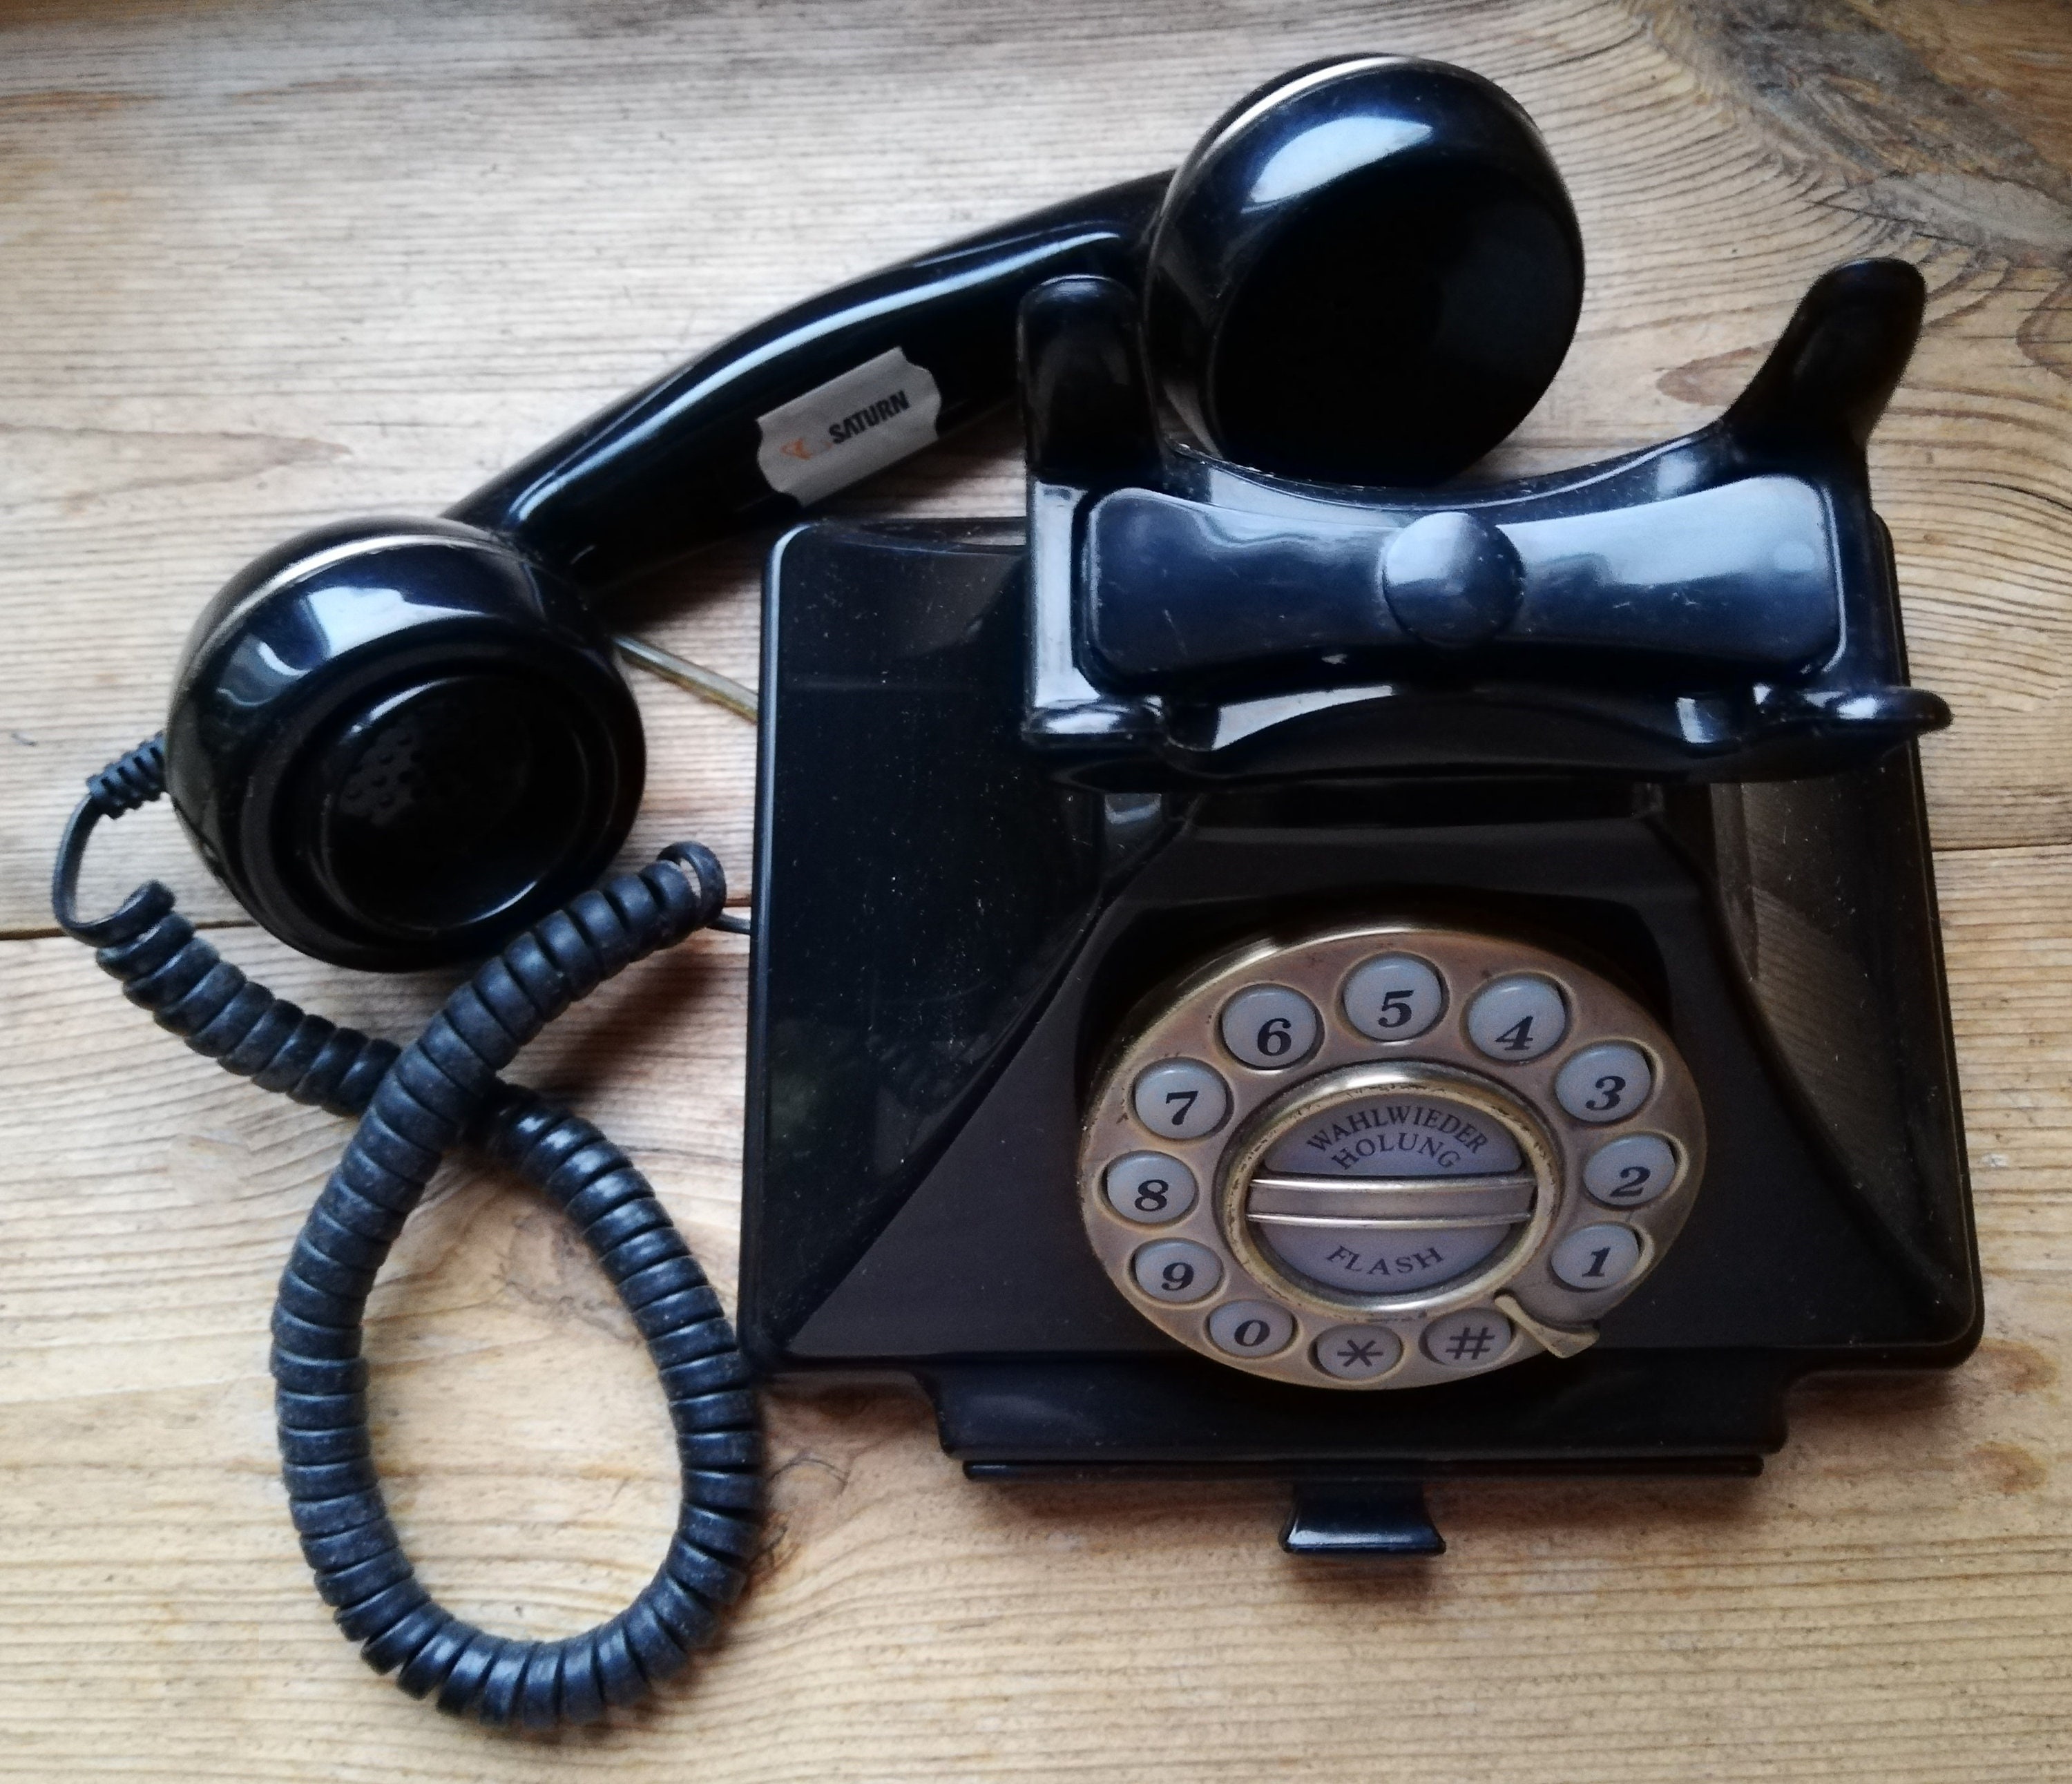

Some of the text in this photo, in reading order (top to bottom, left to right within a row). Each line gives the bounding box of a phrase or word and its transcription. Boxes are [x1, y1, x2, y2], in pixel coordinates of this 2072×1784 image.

[829, 390, 910, 444] SATURN
[1377, 990, 1414, 1029] 5
[1256, 1017, 1292, 1057] 6
[1494, 1015, 1534, 1051] 4
[1165, 1090, 1199, 1126] 7
[1585, 1075, 1627, 1111] 3
[1307, 1104, 1488, 1154] WAHLWIEDER
[1330, 1131, 1461, 1171] HOLUNG
[1133, 1179, 1169, 1212] 8
[1609, 1165, 1651, 1198] 2
[1160, 1261, 1195, 1292] 9
[1325, 1245, 1445, 1276] FLASH
[1581, 1247, 1611, 1278] 1
[1445, 1325, 1496, 1361] #
